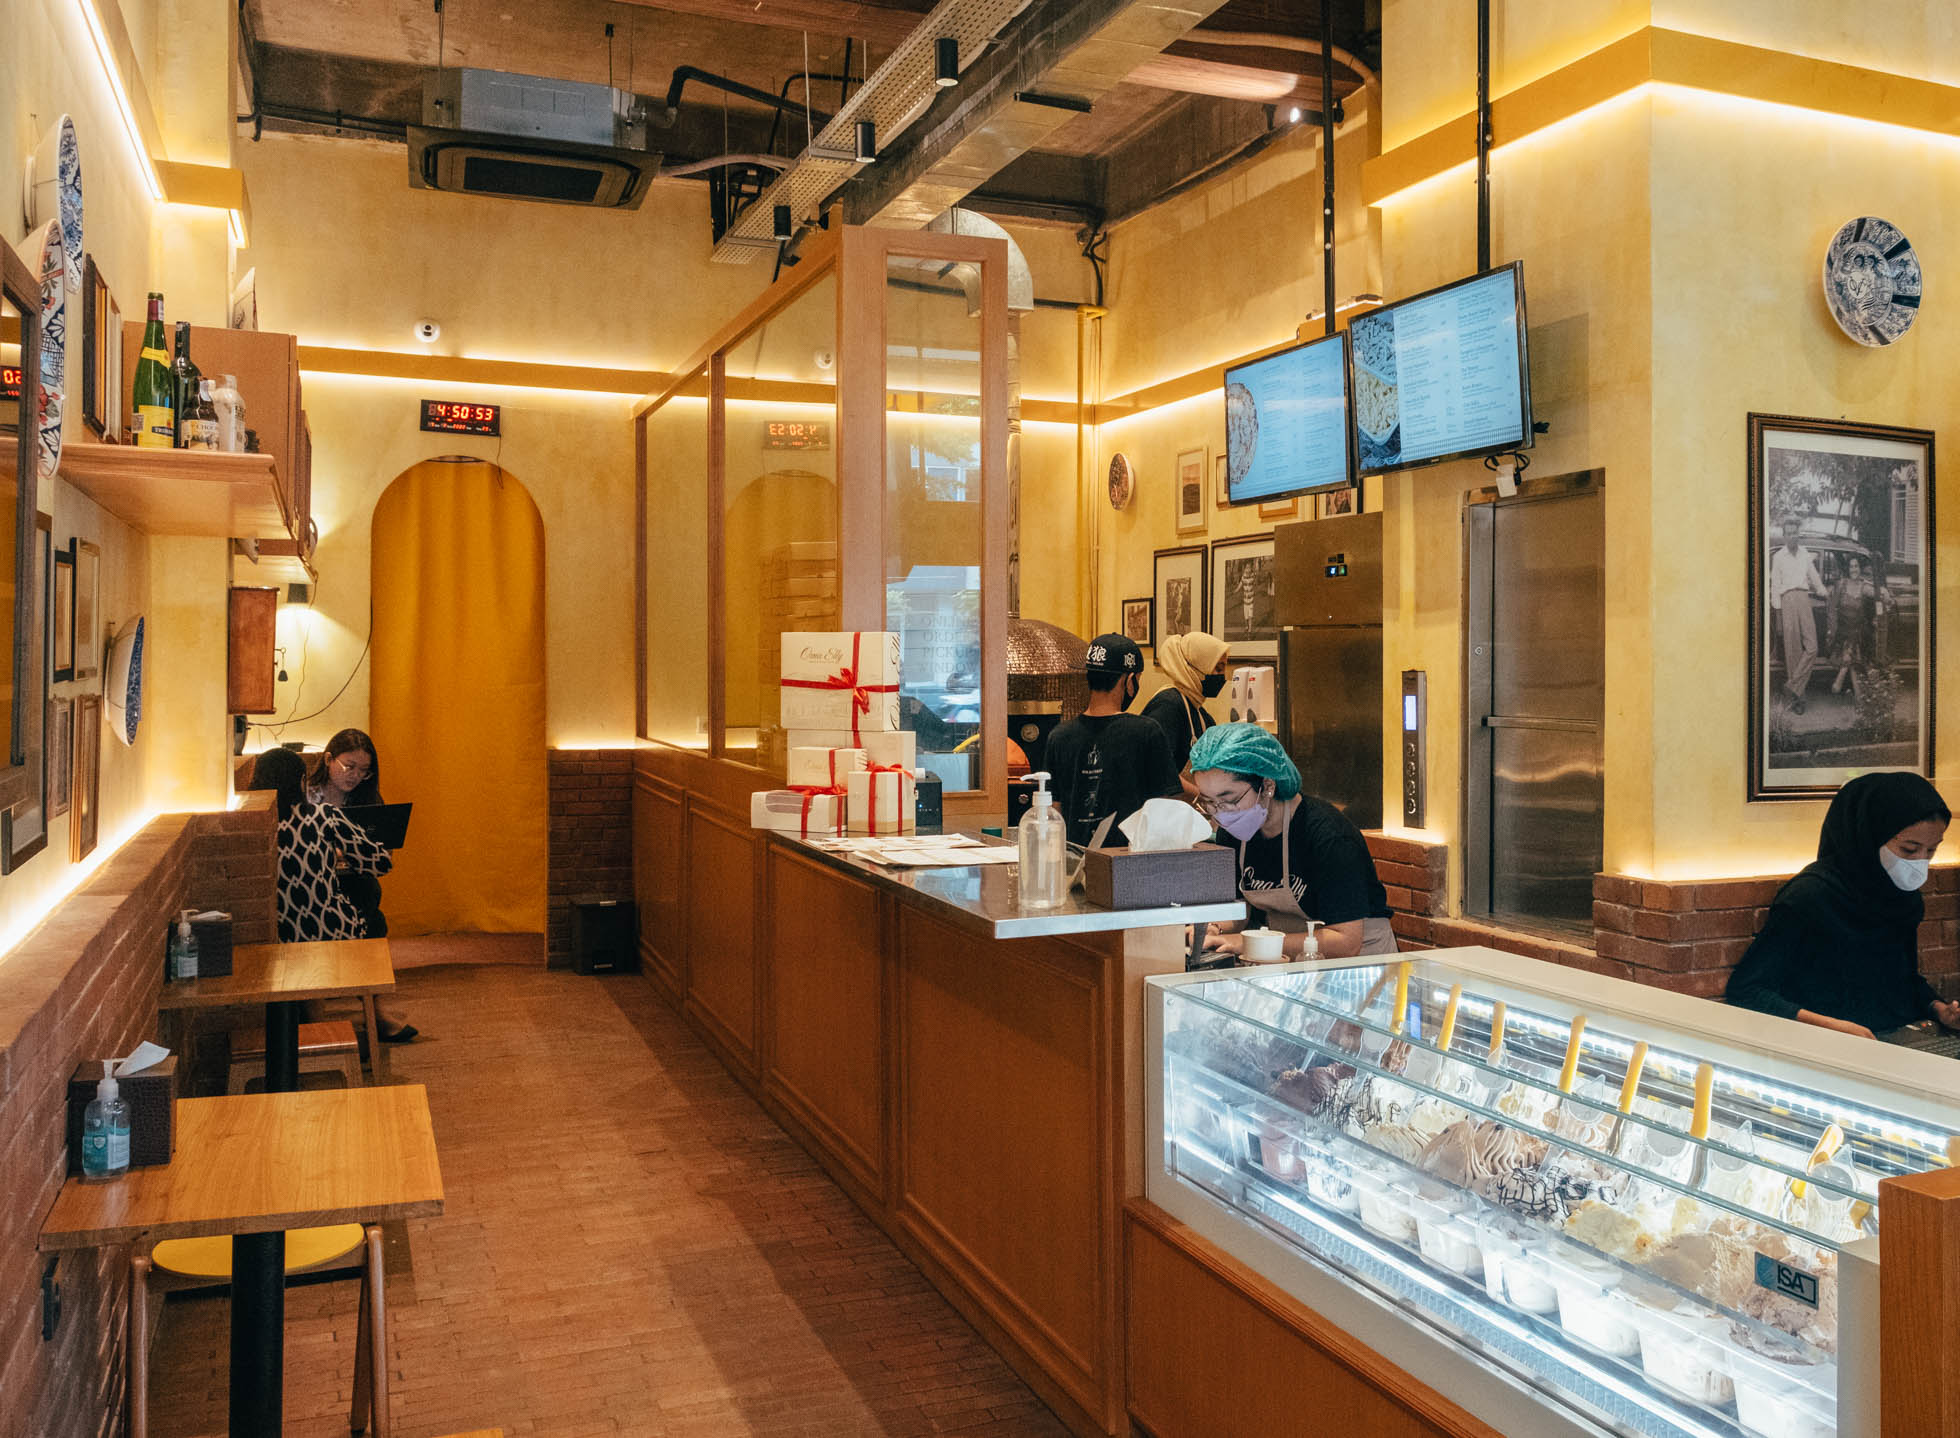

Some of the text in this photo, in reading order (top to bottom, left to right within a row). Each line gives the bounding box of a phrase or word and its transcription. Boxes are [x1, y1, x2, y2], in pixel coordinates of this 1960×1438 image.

[437, 404, 494, 420] 4:50:53
[922, 648, 978, 658] PICKUP
[1777, 1264, 1805, 1293] ISA
